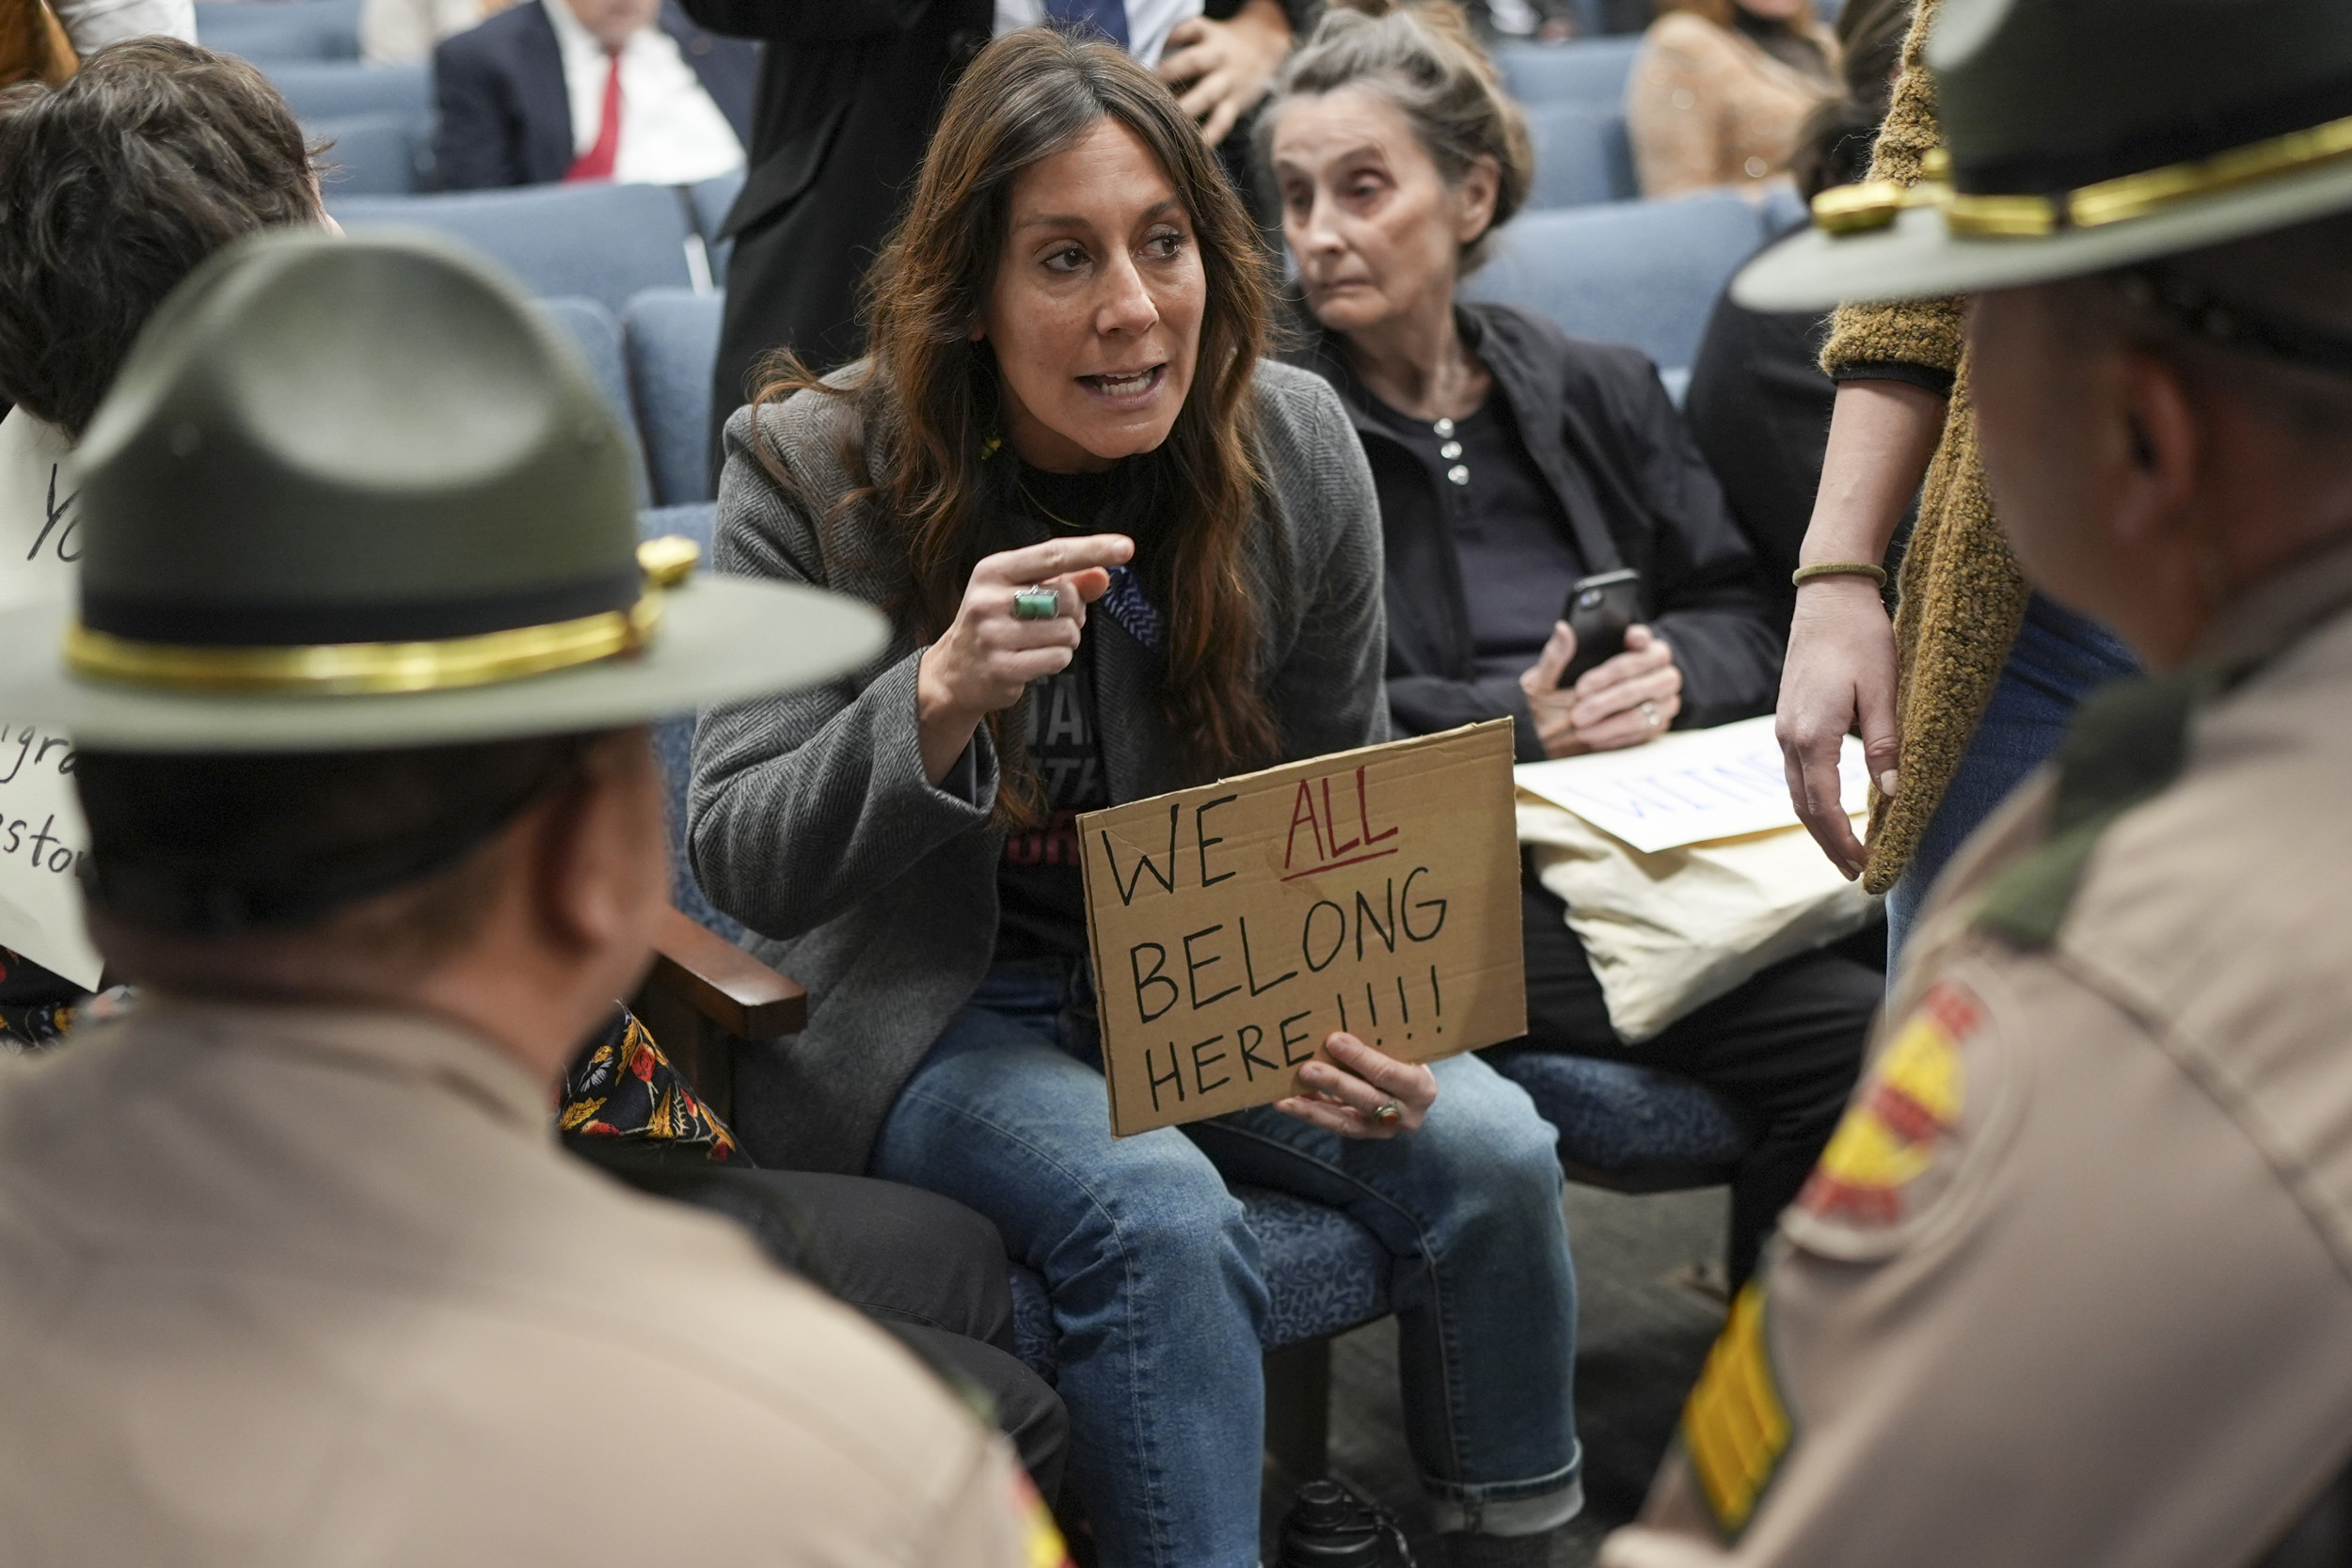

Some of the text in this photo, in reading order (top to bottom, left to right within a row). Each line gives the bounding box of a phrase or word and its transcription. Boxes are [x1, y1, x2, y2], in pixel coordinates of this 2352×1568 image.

[1101, 794, 1238, 907] WE
[1283, 765, 1399, 870] ALL
[1130, 866, 1447, 1024] BELONG
[1145, 965, 1443, 1113] HERE!!!!
